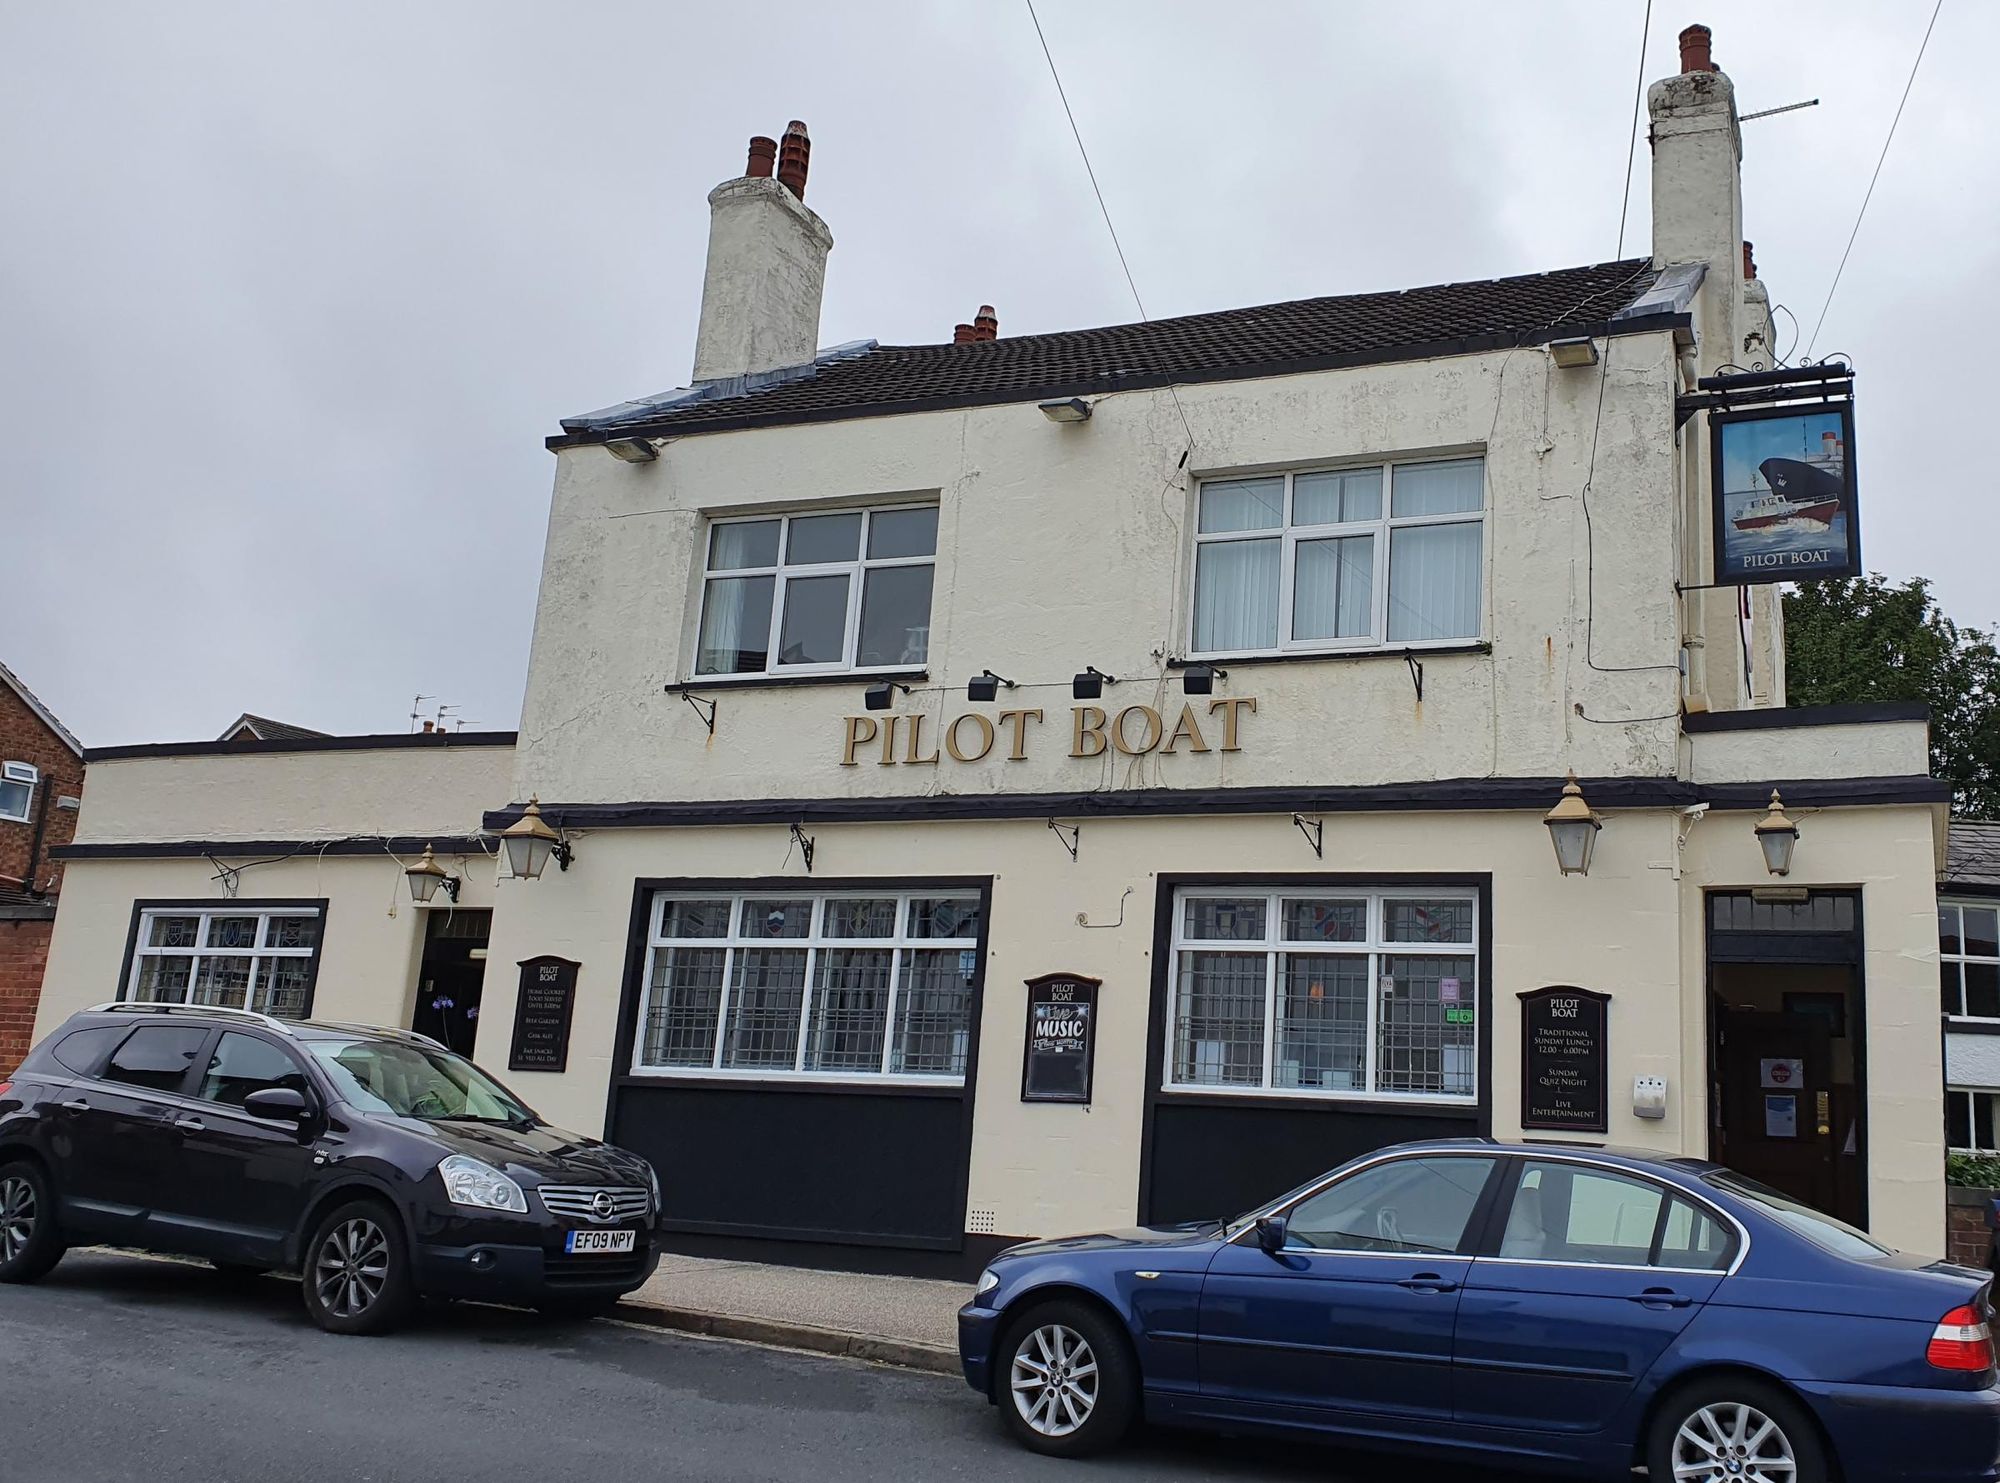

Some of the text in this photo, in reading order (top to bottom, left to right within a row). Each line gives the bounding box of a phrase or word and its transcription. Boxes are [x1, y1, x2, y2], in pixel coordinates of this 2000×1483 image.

[1743, 550, 1831, 567] PILOT BOAT
[839, 697, 1257, 766] PILOT BOAT
[540, 966, 559, 974] PILOT
[540, 973, 557, 981] BOAT
[1051, 984, 1075, 992] PILOT
[1052, 993, 1074, 1001] BOAT
[1550, 999, 1579, 1009] PILOT
[1551, 1008, 1578, 1018] BOAT
[1036, 1020, 1084, 1037] MUSIC
[1538, 1028, 1589, 1038] TRADITIONAL
[1534, 1037, 1593, 1046] SUNDAY LUNCH
[1539, 1046, 1557, 1054] 12.00
[1548, 1068, 1579, 1077] SUNDAY
[1539, 1077, 1588, 1087] QUIZ NIGHT
[1555, 1099, 1571, 1108] LIVE
[1532, 1107, 1595, 1118] ENTERTAINMENT
[575, 1233, 633, 1248] EF09 NPY
